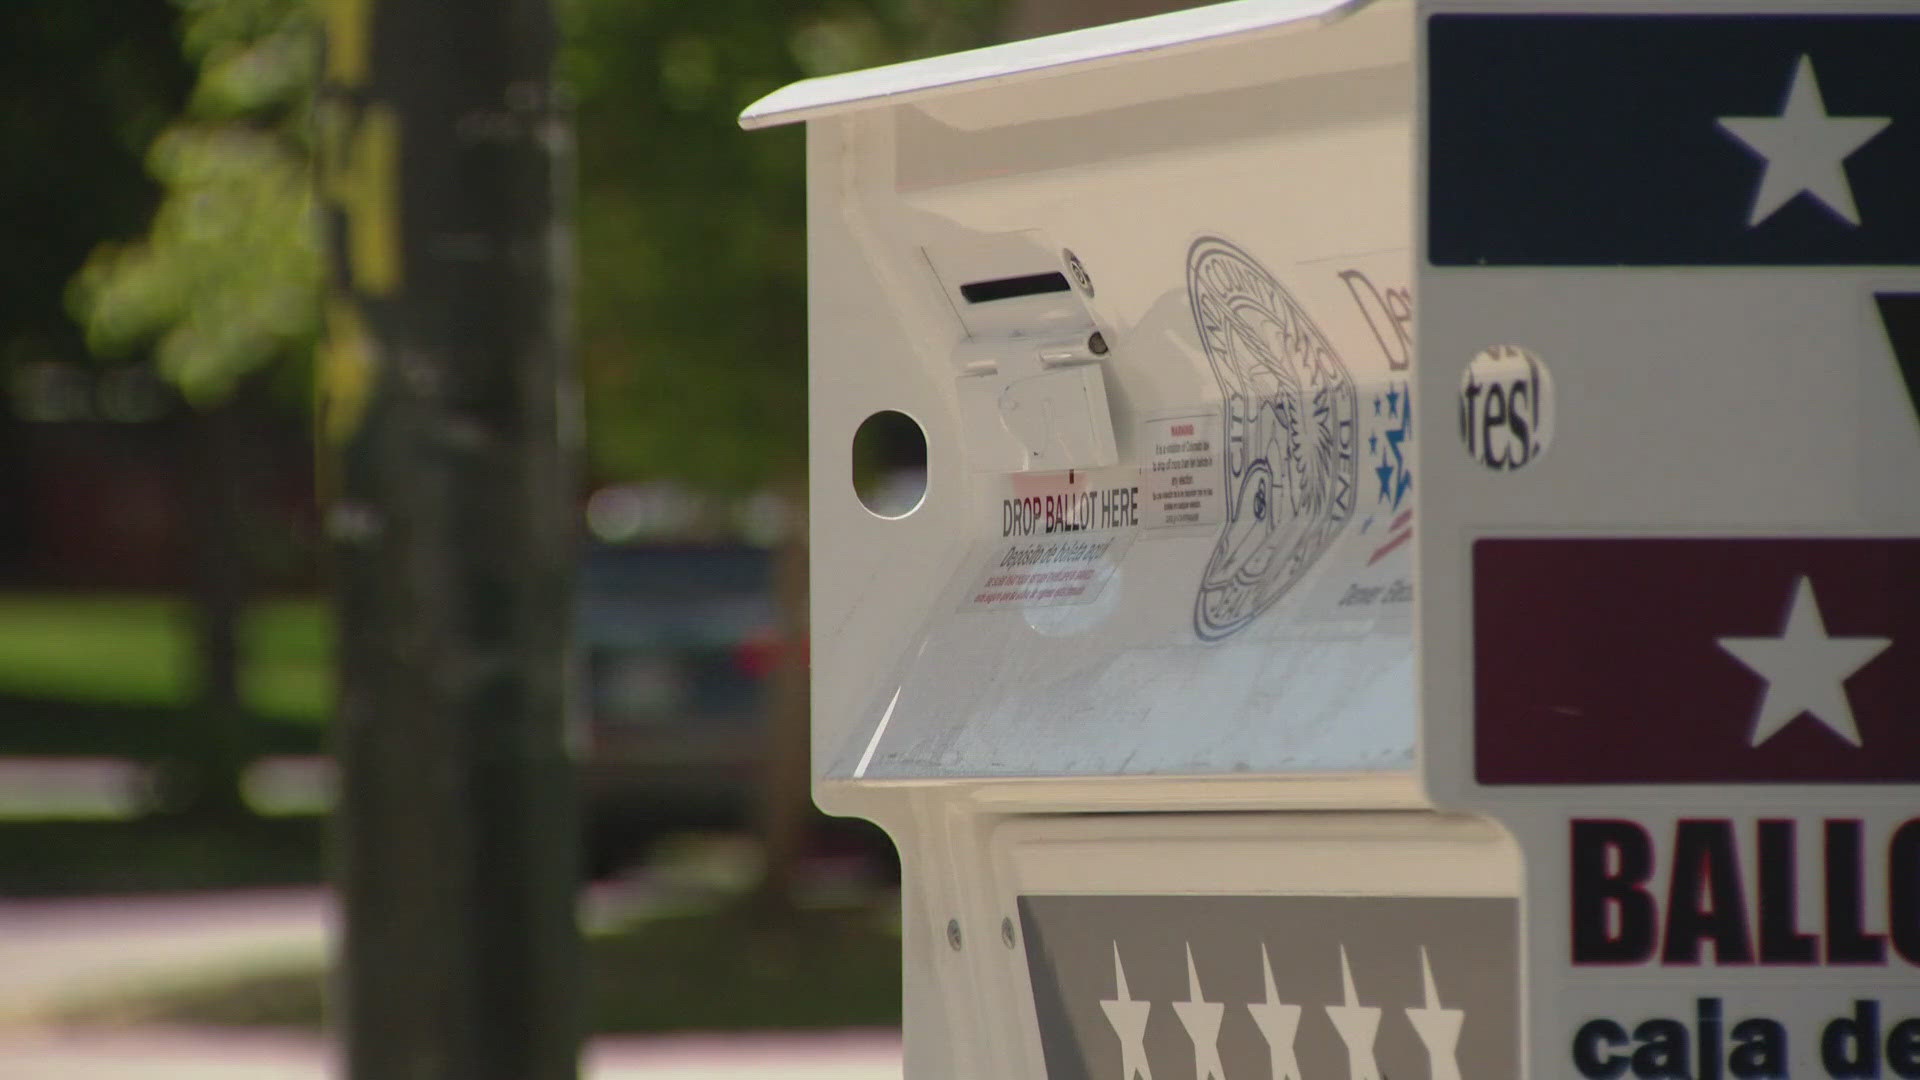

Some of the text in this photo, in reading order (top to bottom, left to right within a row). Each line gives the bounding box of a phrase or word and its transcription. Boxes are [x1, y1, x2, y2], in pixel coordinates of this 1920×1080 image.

[1338, 270, 1412, 370] De
[1003, 486, 1139, 537] DROP BALLOT HERE
[1040, 543, 1058, 563] de
[1572, 997, 1791, 1080] caja
